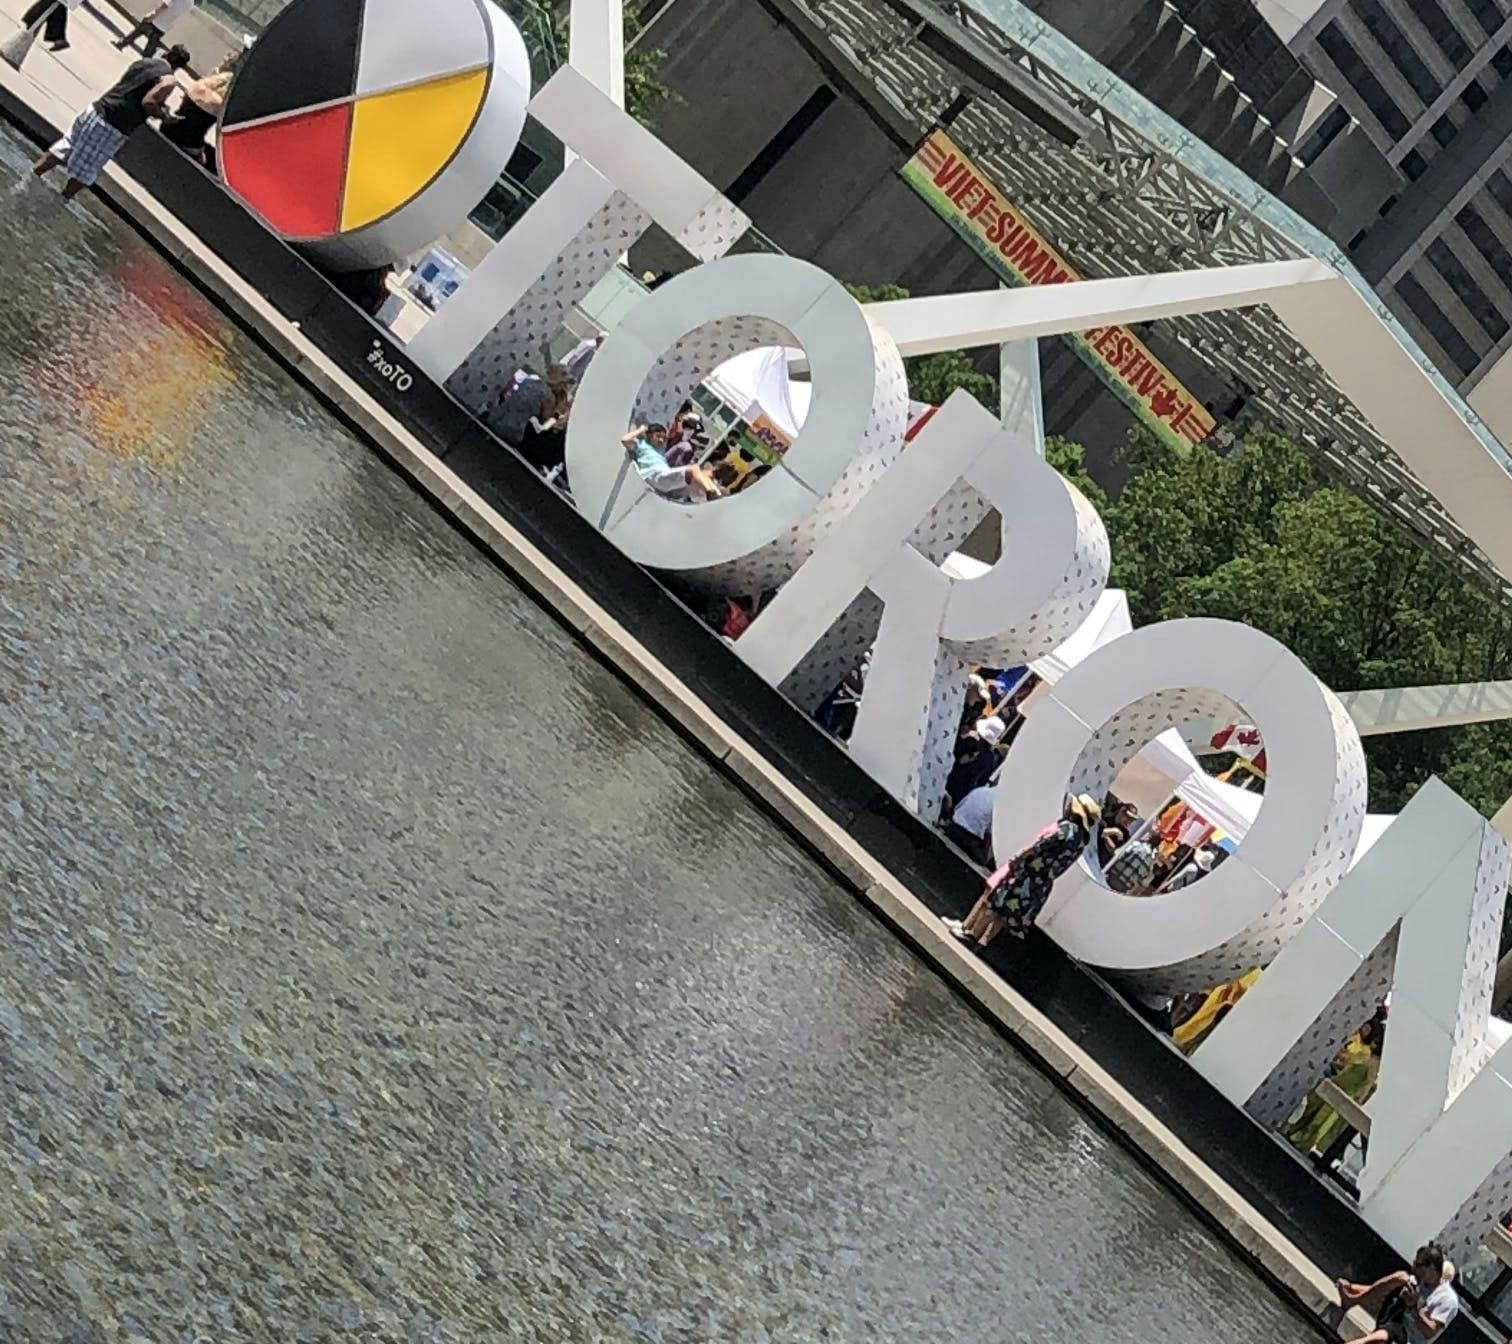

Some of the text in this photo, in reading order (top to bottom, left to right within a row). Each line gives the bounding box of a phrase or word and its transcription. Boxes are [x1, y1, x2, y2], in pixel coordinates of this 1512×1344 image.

[932, 153, 995, 220] VIET
[986, 211, 1077, 285] SUMM
[367, 349, 413, 391] #xoTO
